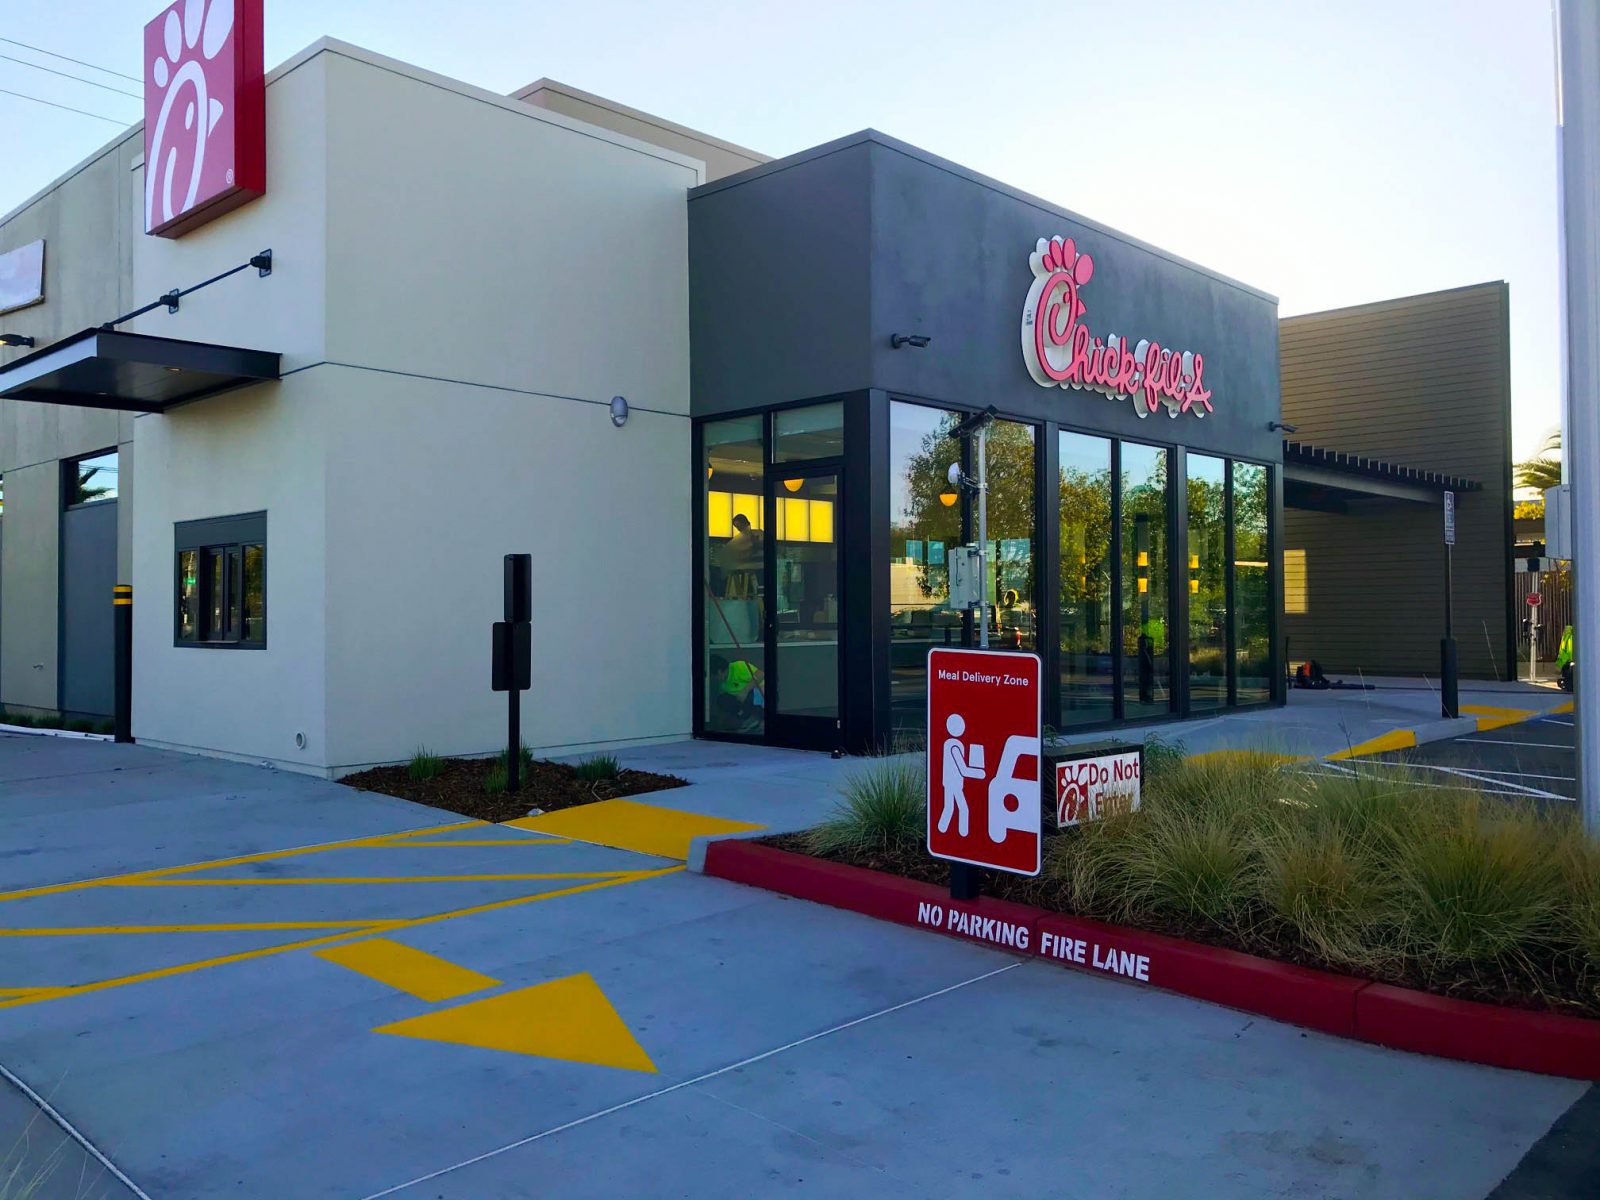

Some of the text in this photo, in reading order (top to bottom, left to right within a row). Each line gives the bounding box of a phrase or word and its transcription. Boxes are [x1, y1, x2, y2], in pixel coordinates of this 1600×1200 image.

[938, 669, 1029, 686] Meal Delivery Zone
[1088, 758, 1139, 786] Do Not
[917, 902, 1150, 982] NO PARKING FIRE LANE
